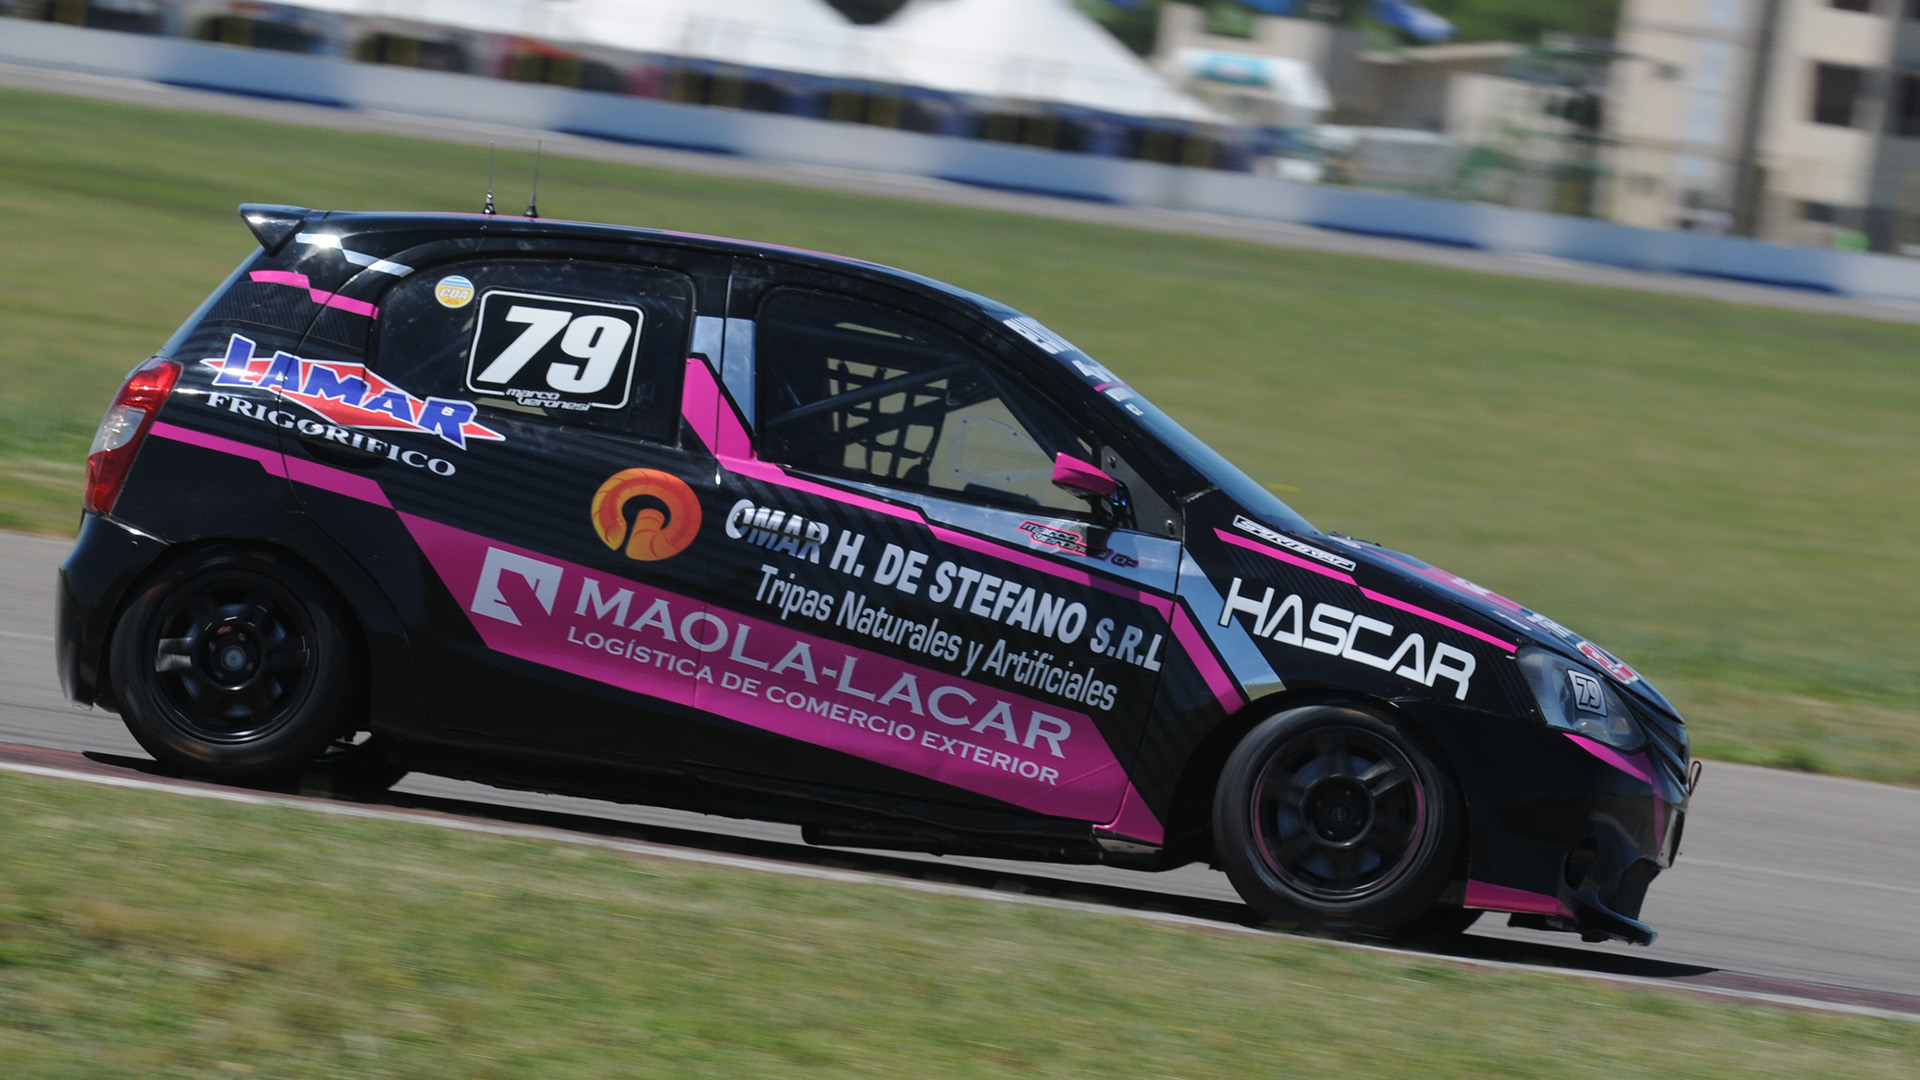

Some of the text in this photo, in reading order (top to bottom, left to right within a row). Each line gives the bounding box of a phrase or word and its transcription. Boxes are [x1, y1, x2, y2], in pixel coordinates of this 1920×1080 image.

[211, 333, 478, 451] LAMAR
[477, 304, 632, 393] 79
[506, 388, 560, 400] marco
[206, 393, 456, 477] FRIGORIFICO
[725, 499, 829, 564] OMAR
[829, 529, 866, 577] H.
[873, 543, 929, 594] DE
[929, 561, 1087, 644] STEFANO
[573, 576, 1072, 759] MAOLA-LACAR
[755, 564, 1119, 711] Tripas Naturales y Artificiales
[1219, 577, 1477, 701] HASCAR
[1575, 676, 1602, 709] 79
[566, 626, 1060, 786] LOGÍSTICA DE COMERCIO EXTERIOR
